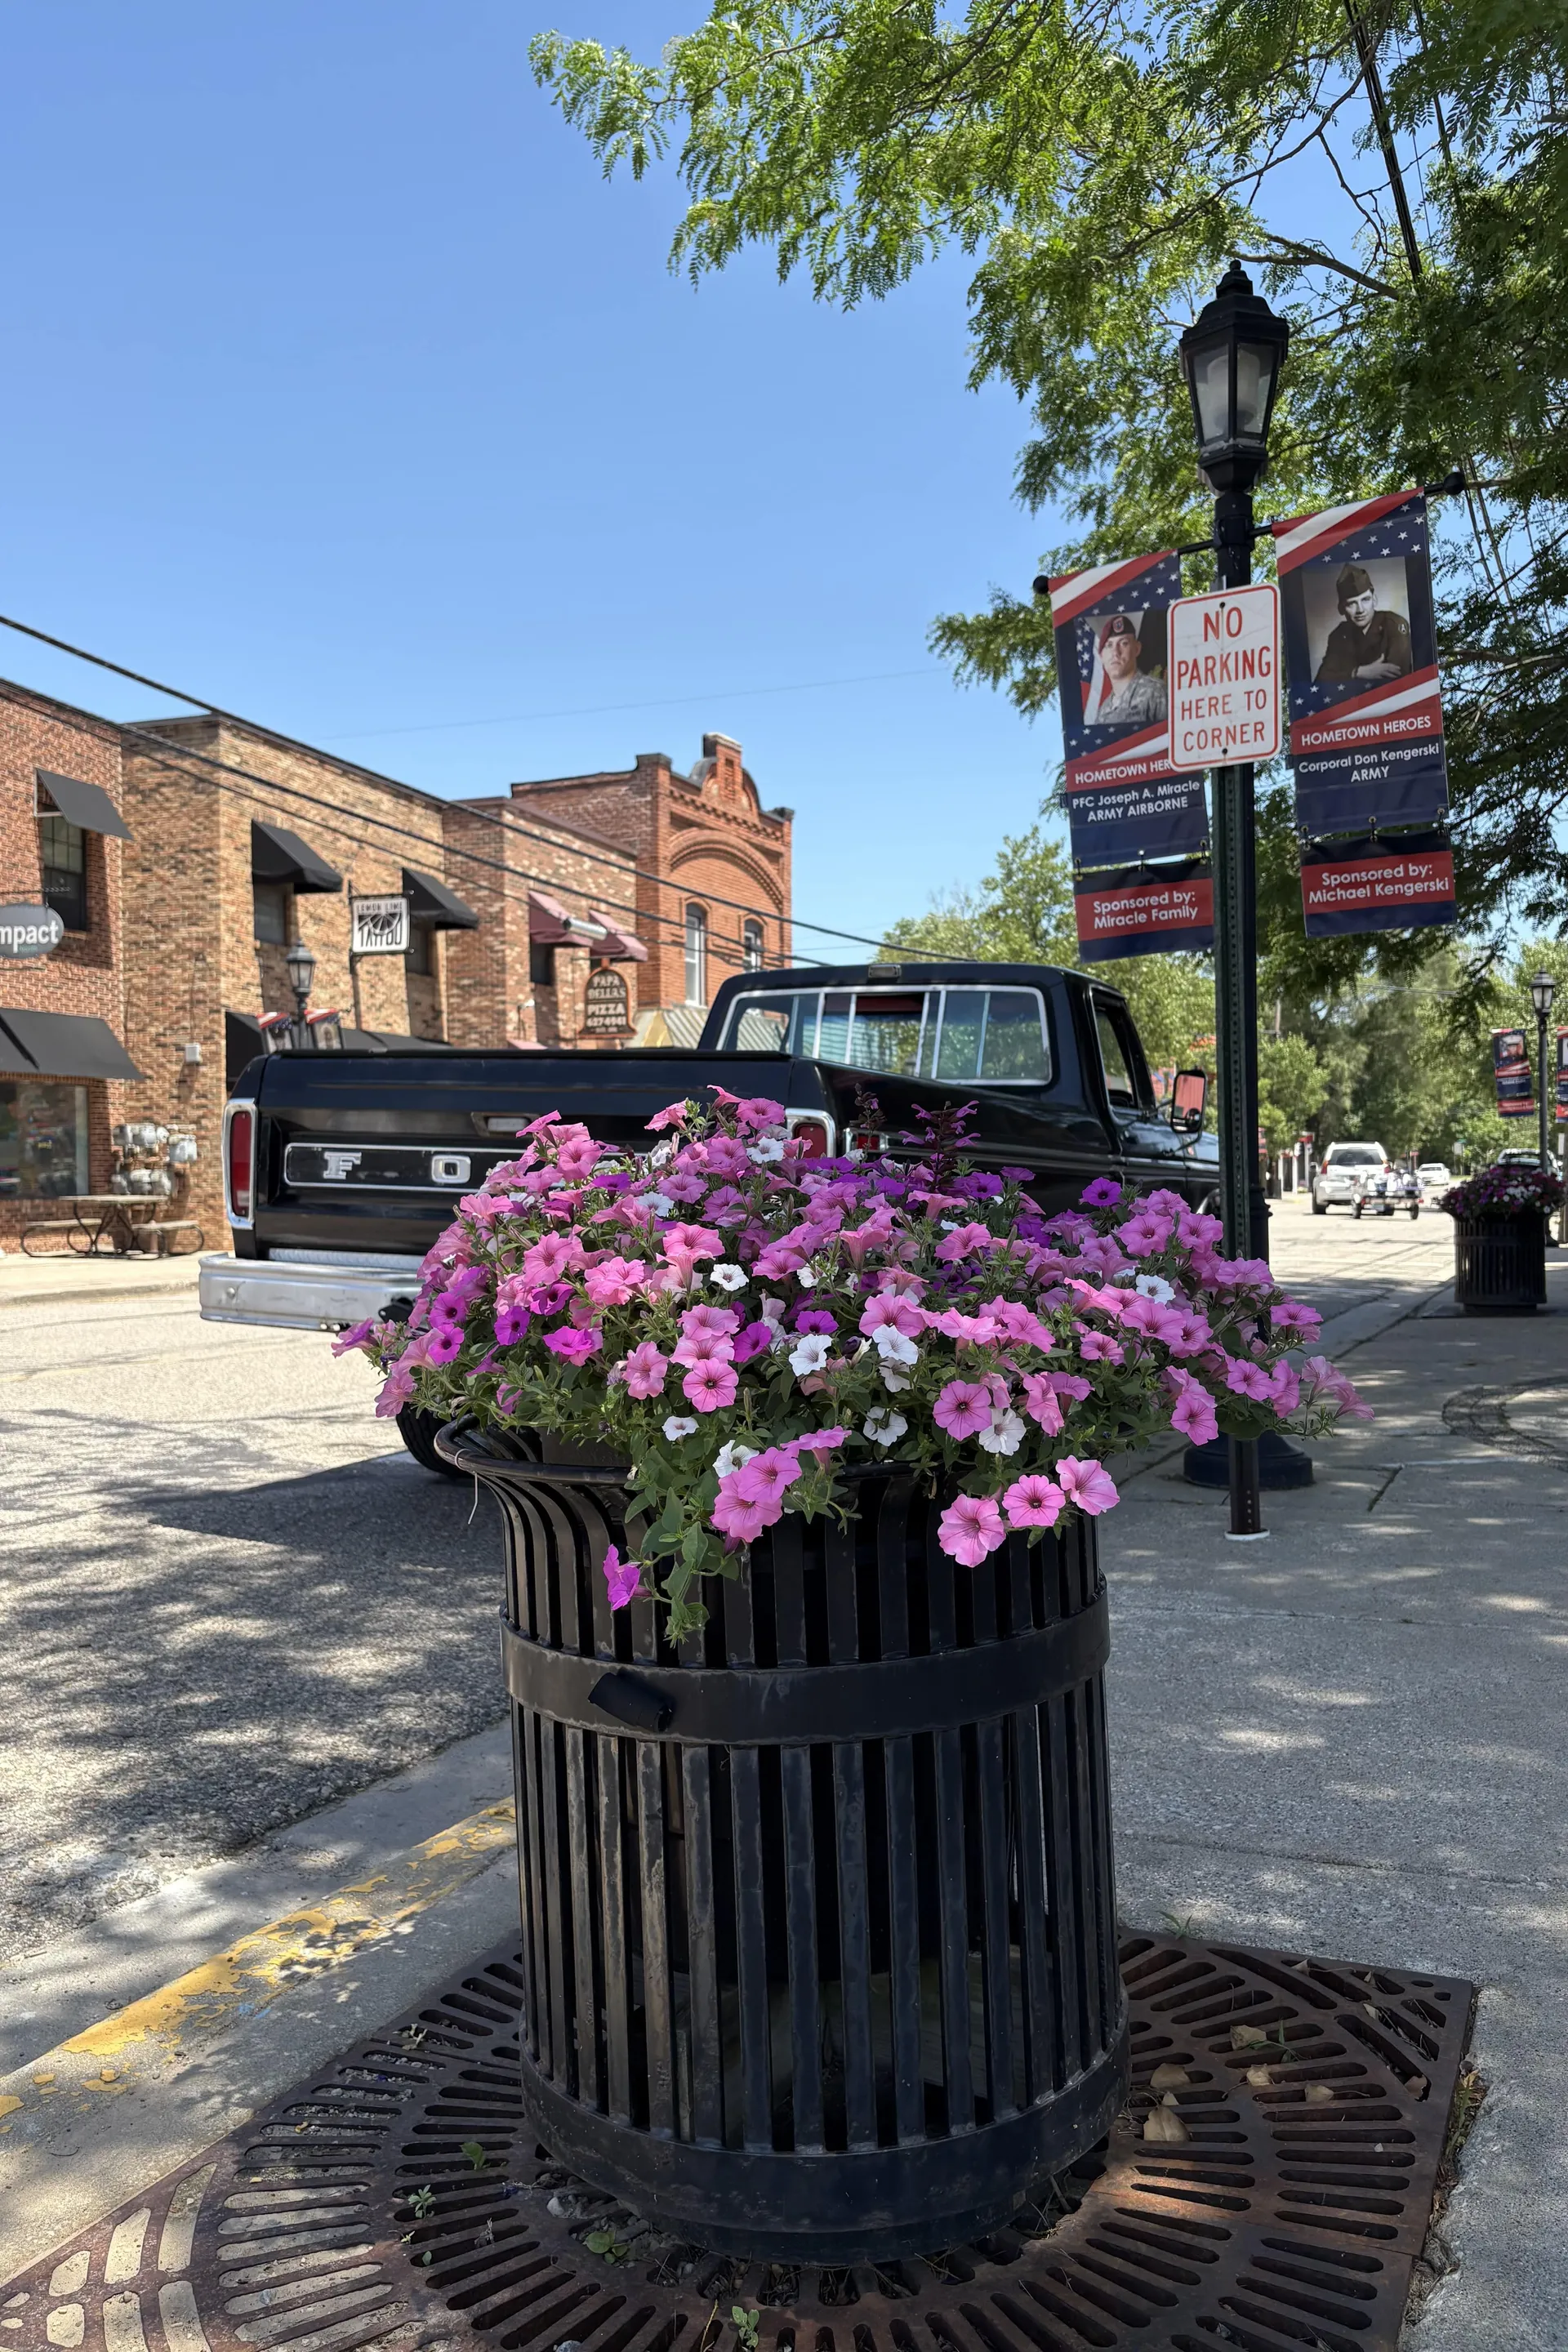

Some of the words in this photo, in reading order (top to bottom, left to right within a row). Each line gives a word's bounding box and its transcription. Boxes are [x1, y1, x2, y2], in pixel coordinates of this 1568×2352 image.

[1203, 606, 1243, 643] NO
[1177, 645, 1272, 690] PARKING
[1180, 693, 1232, 721] HERE
[1244, 688, 1267, 711] TO
[1183, 721, 1265, 752] CORNER
[1301, 724, 1380, 746] HOMETOWN
[1383, 715, 1432, 734] HEROES
[1298, 755, 1352, 773] Corporal
[1354, 754, 1378, 766] Don
[1381, 743, 1440, 764] Kengerski
[1075, 763, 1147, 785] HOMETOWN
[1150, 760, 1173, 773] HER
[1350, 765, 1390, 783] ARMY
[1072, 795, 1095, 809] PFC
[1098, 790, 1139, 807] Joseph
[1142, 787, 1155, 799] A.
[1157, 780, 1200, 795] Miracle
[1087, 807, 1125, 823] ARMY
[1127, 795, 1189, 817] AIRBORNE
[1321, 863, 1405, 888] Sponsored
[1409, 862, 1432, 878] by:
[1093, 891, 1169, 915] Sponsored
[1173, 890, 1196, 905] by:
[1308, 884, 1371, 904] Michael
[1375, 877, 1450, 897] Kengerski
[1094, 911, 1147, 929] Miracle
[1152, 905, 1198, 922] Family
[593, 975, 621, 987] PAPA
[587, 1003, 626, 1015] PIZZA
[323, 1152, 471, 1184] FO
